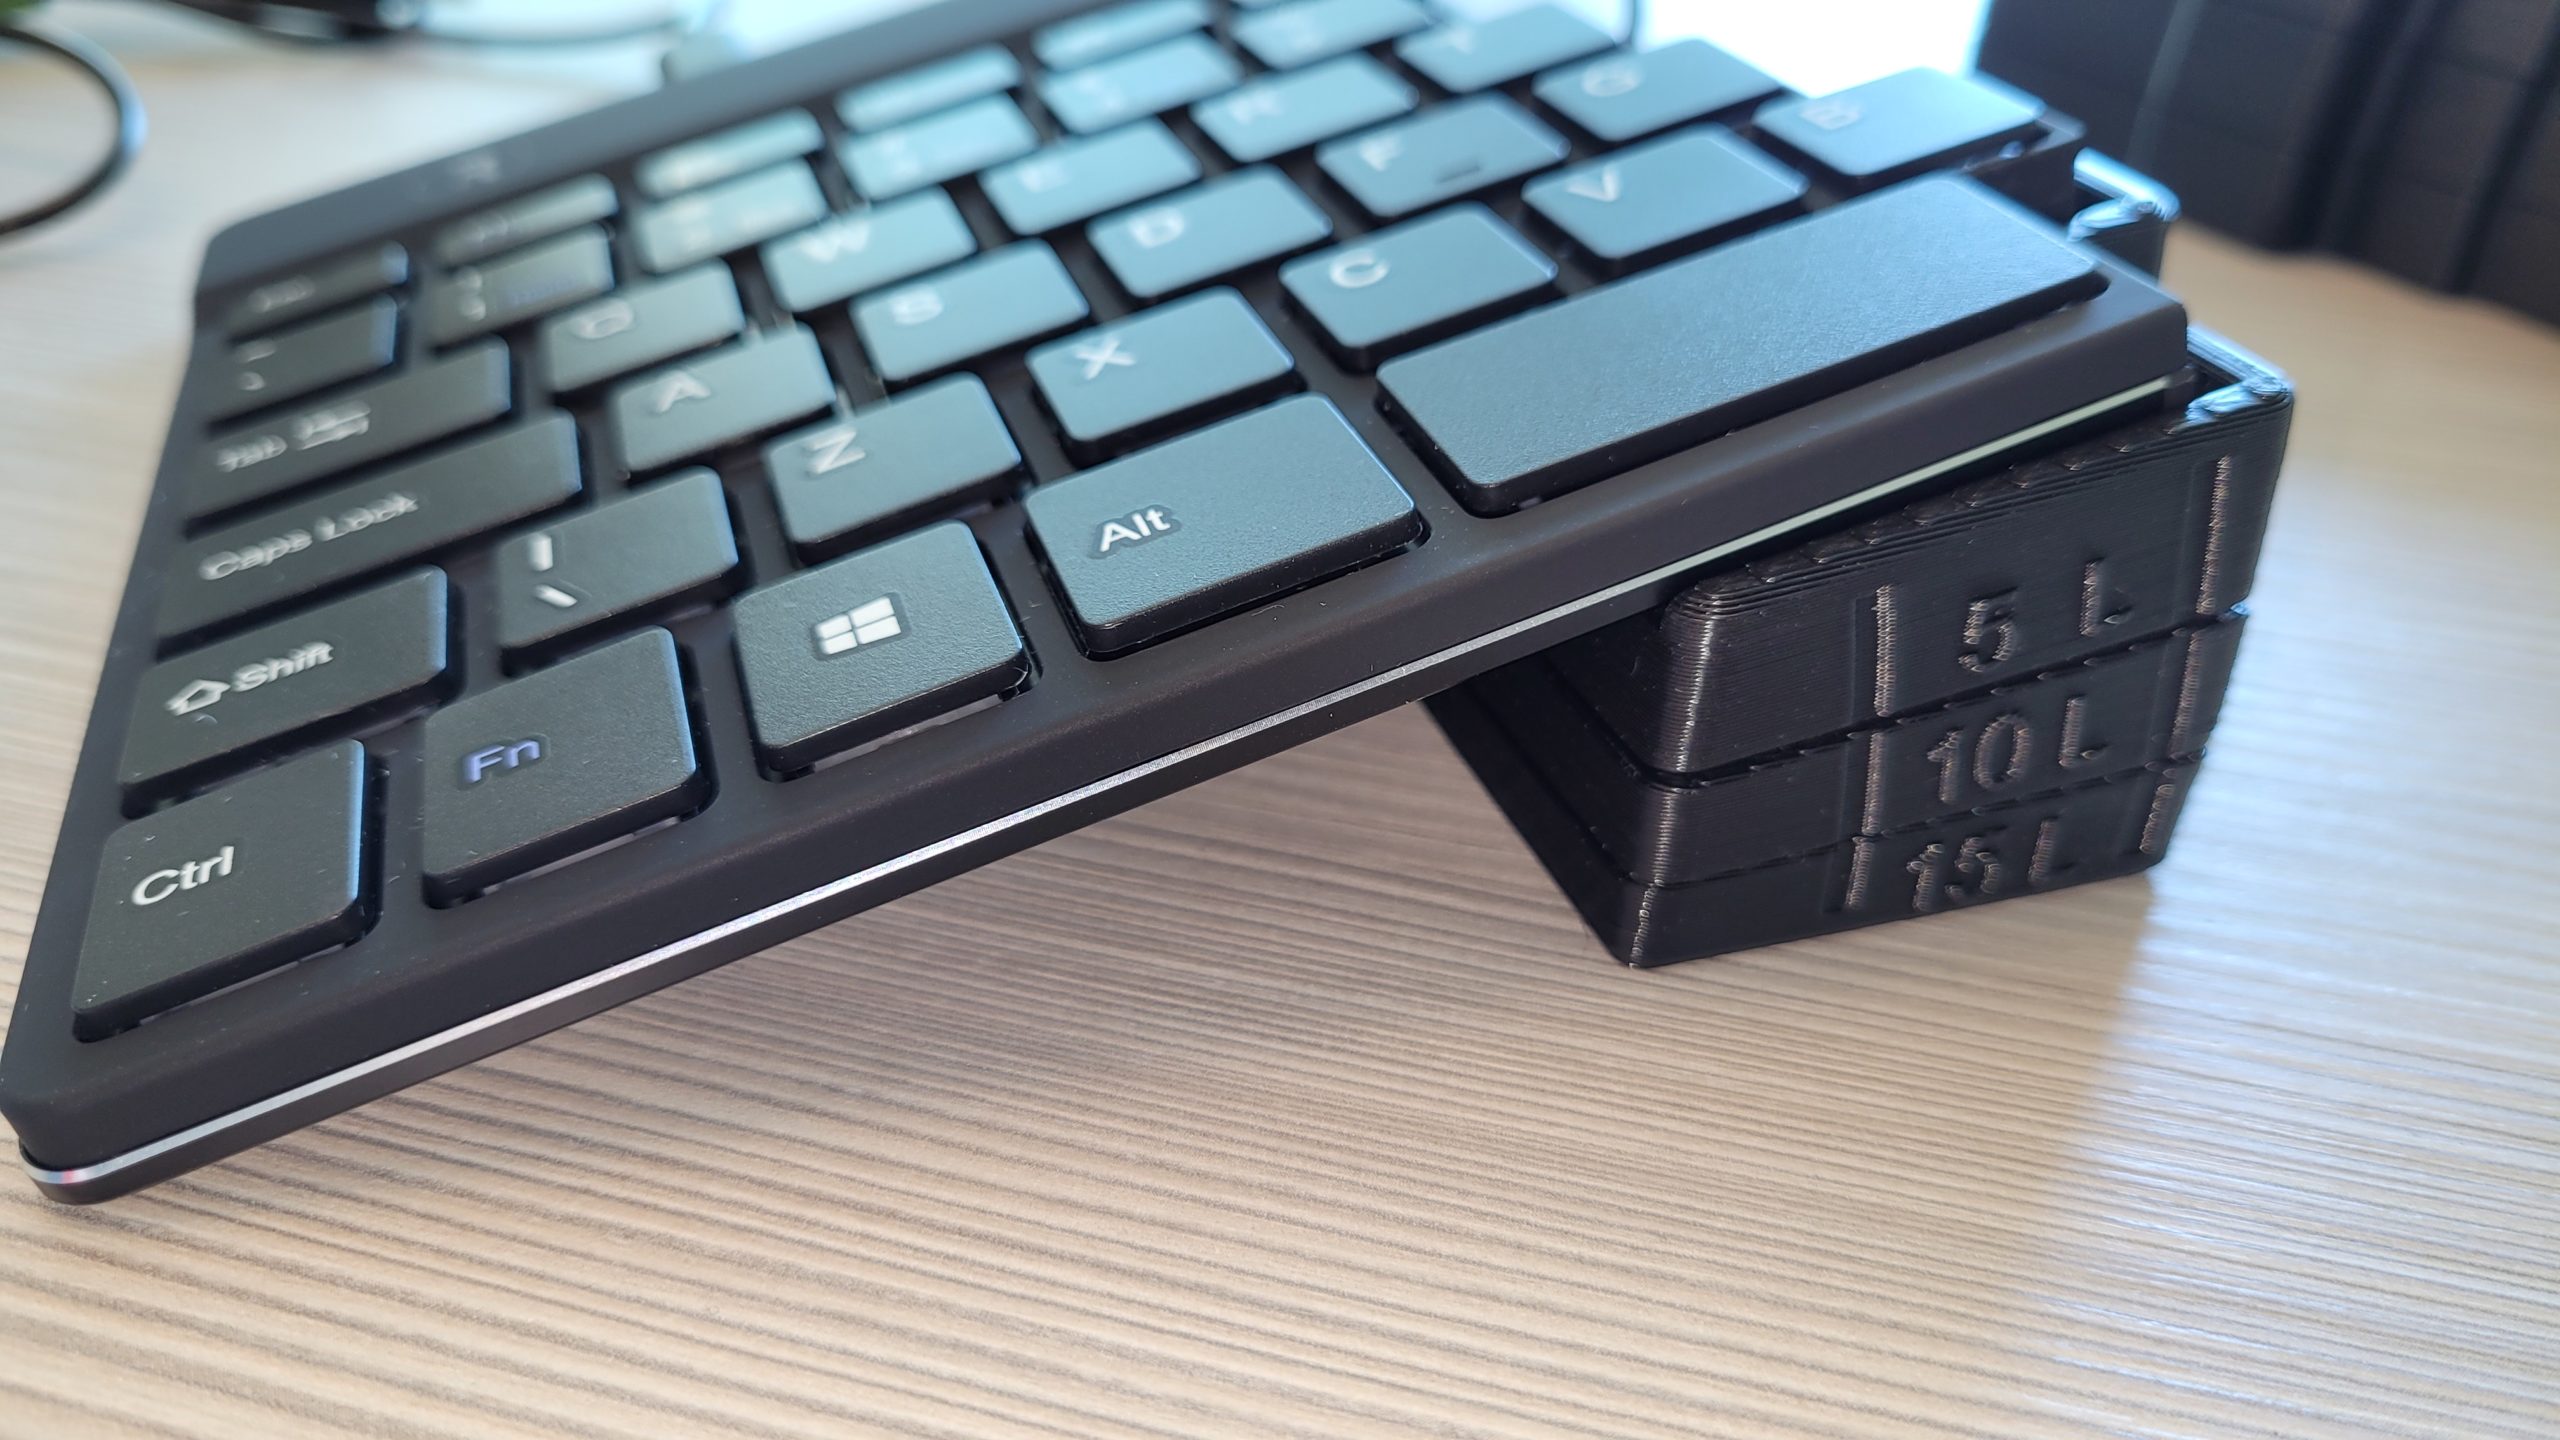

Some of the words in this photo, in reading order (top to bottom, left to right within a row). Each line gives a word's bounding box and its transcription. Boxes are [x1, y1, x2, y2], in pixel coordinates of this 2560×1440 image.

[1566, 164, 1622, 204] V
[1328, 249, 1391, 290] C
[1073, 337, 1137, 381] X
[653, 367, 711, 415] A
[199, 528, 313, 581] Caps
[313, 492, 419, 542] Lock
[1098, 508, 1173, 554] Alt
[1957, 586, 2018, 674] 5
[231, 641, 335, 693] Shift
[463, 736, 541, 783] Fn
[1926, 709, 2034, 805] 10
[131, 845, 235, 906] Ctrl
[1905, 825, 2007, 912] 15
